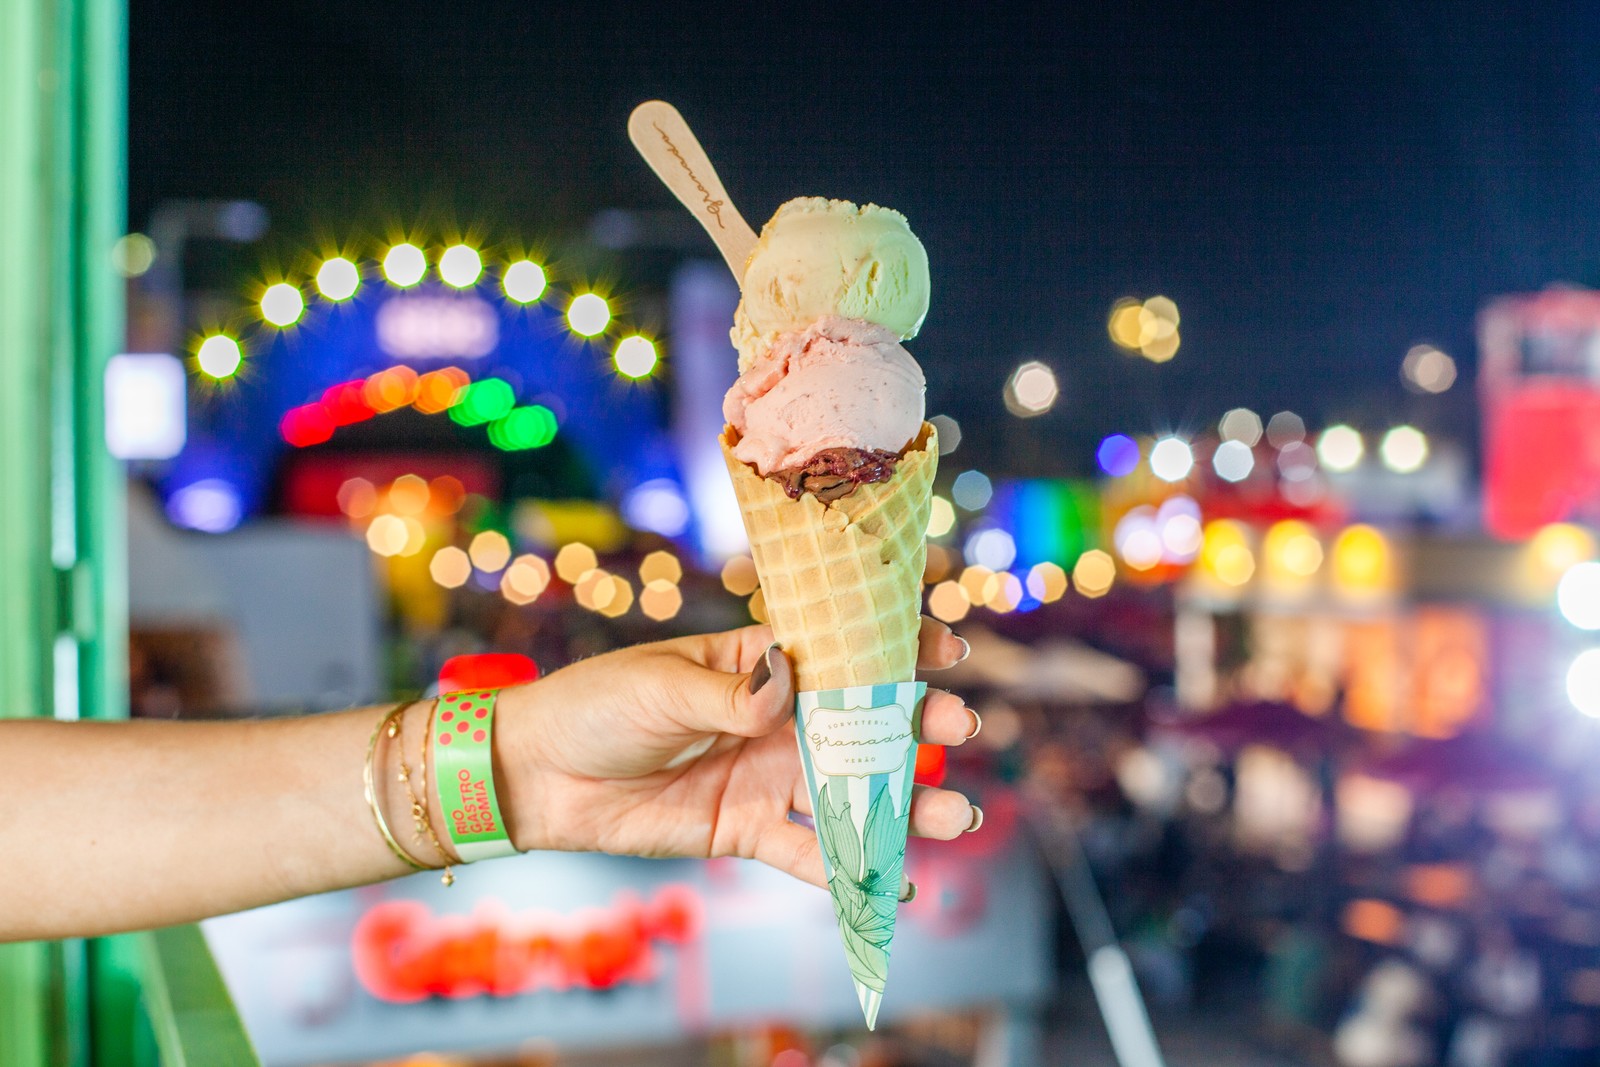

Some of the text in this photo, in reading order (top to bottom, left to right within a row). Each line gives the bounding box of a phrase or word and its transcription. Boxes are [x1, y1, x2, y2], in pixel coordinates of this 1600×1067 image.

[653, 121, 725, 229] Granado
[810, 732, 911, 751] Granado
[828, 719, 889, 730] SORVETERIA
[458, 768, 482, 834] GASTRO
[473, 780, 497, 832] NOMIA
[452, 809, 469, 835] RIO
